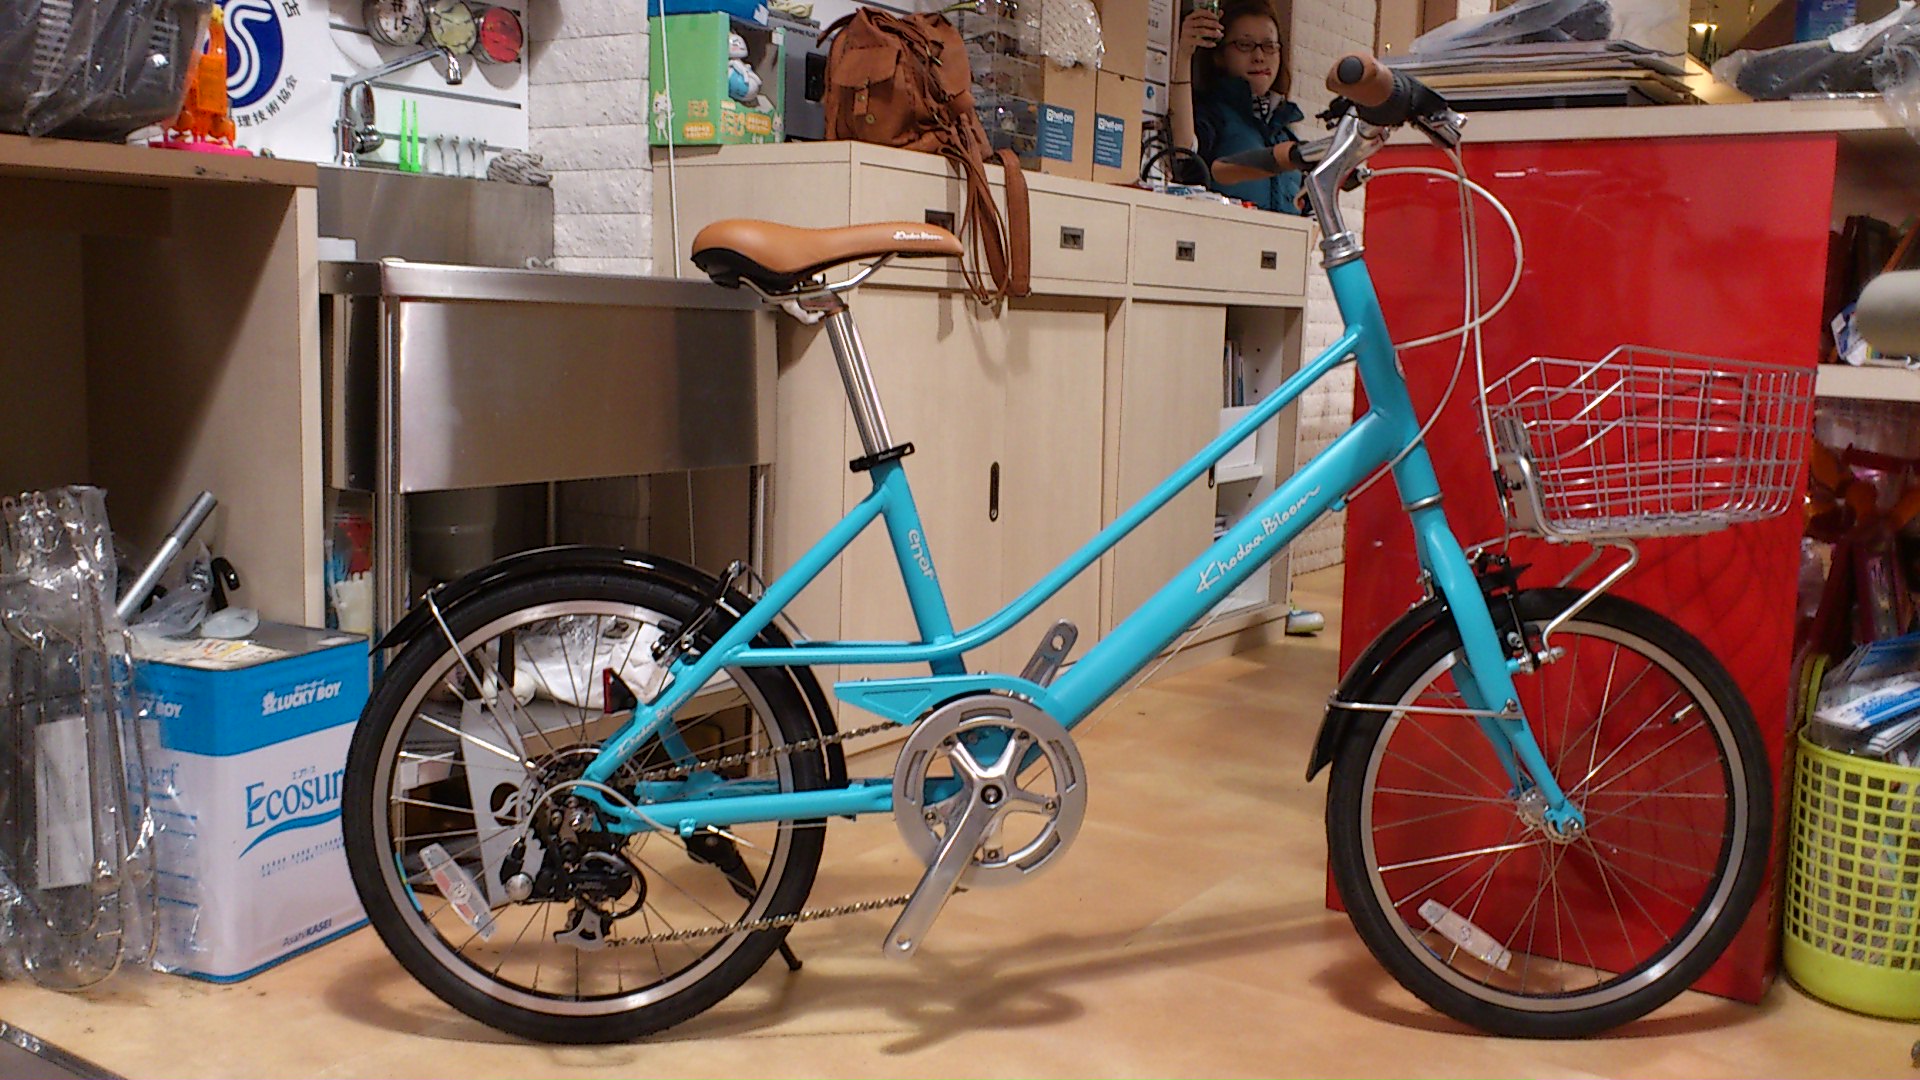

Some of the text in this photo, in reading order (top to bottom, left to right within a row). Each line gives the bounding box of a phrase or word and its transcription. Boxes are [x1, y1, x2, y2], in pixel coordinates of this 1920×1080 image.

[1261, 485, 1320, 536] Bloom
[277, 688, 316, 712] LUCKY
[316, 681, 342, 702] BOY
[245, 768, 345, 830] Ecosur
